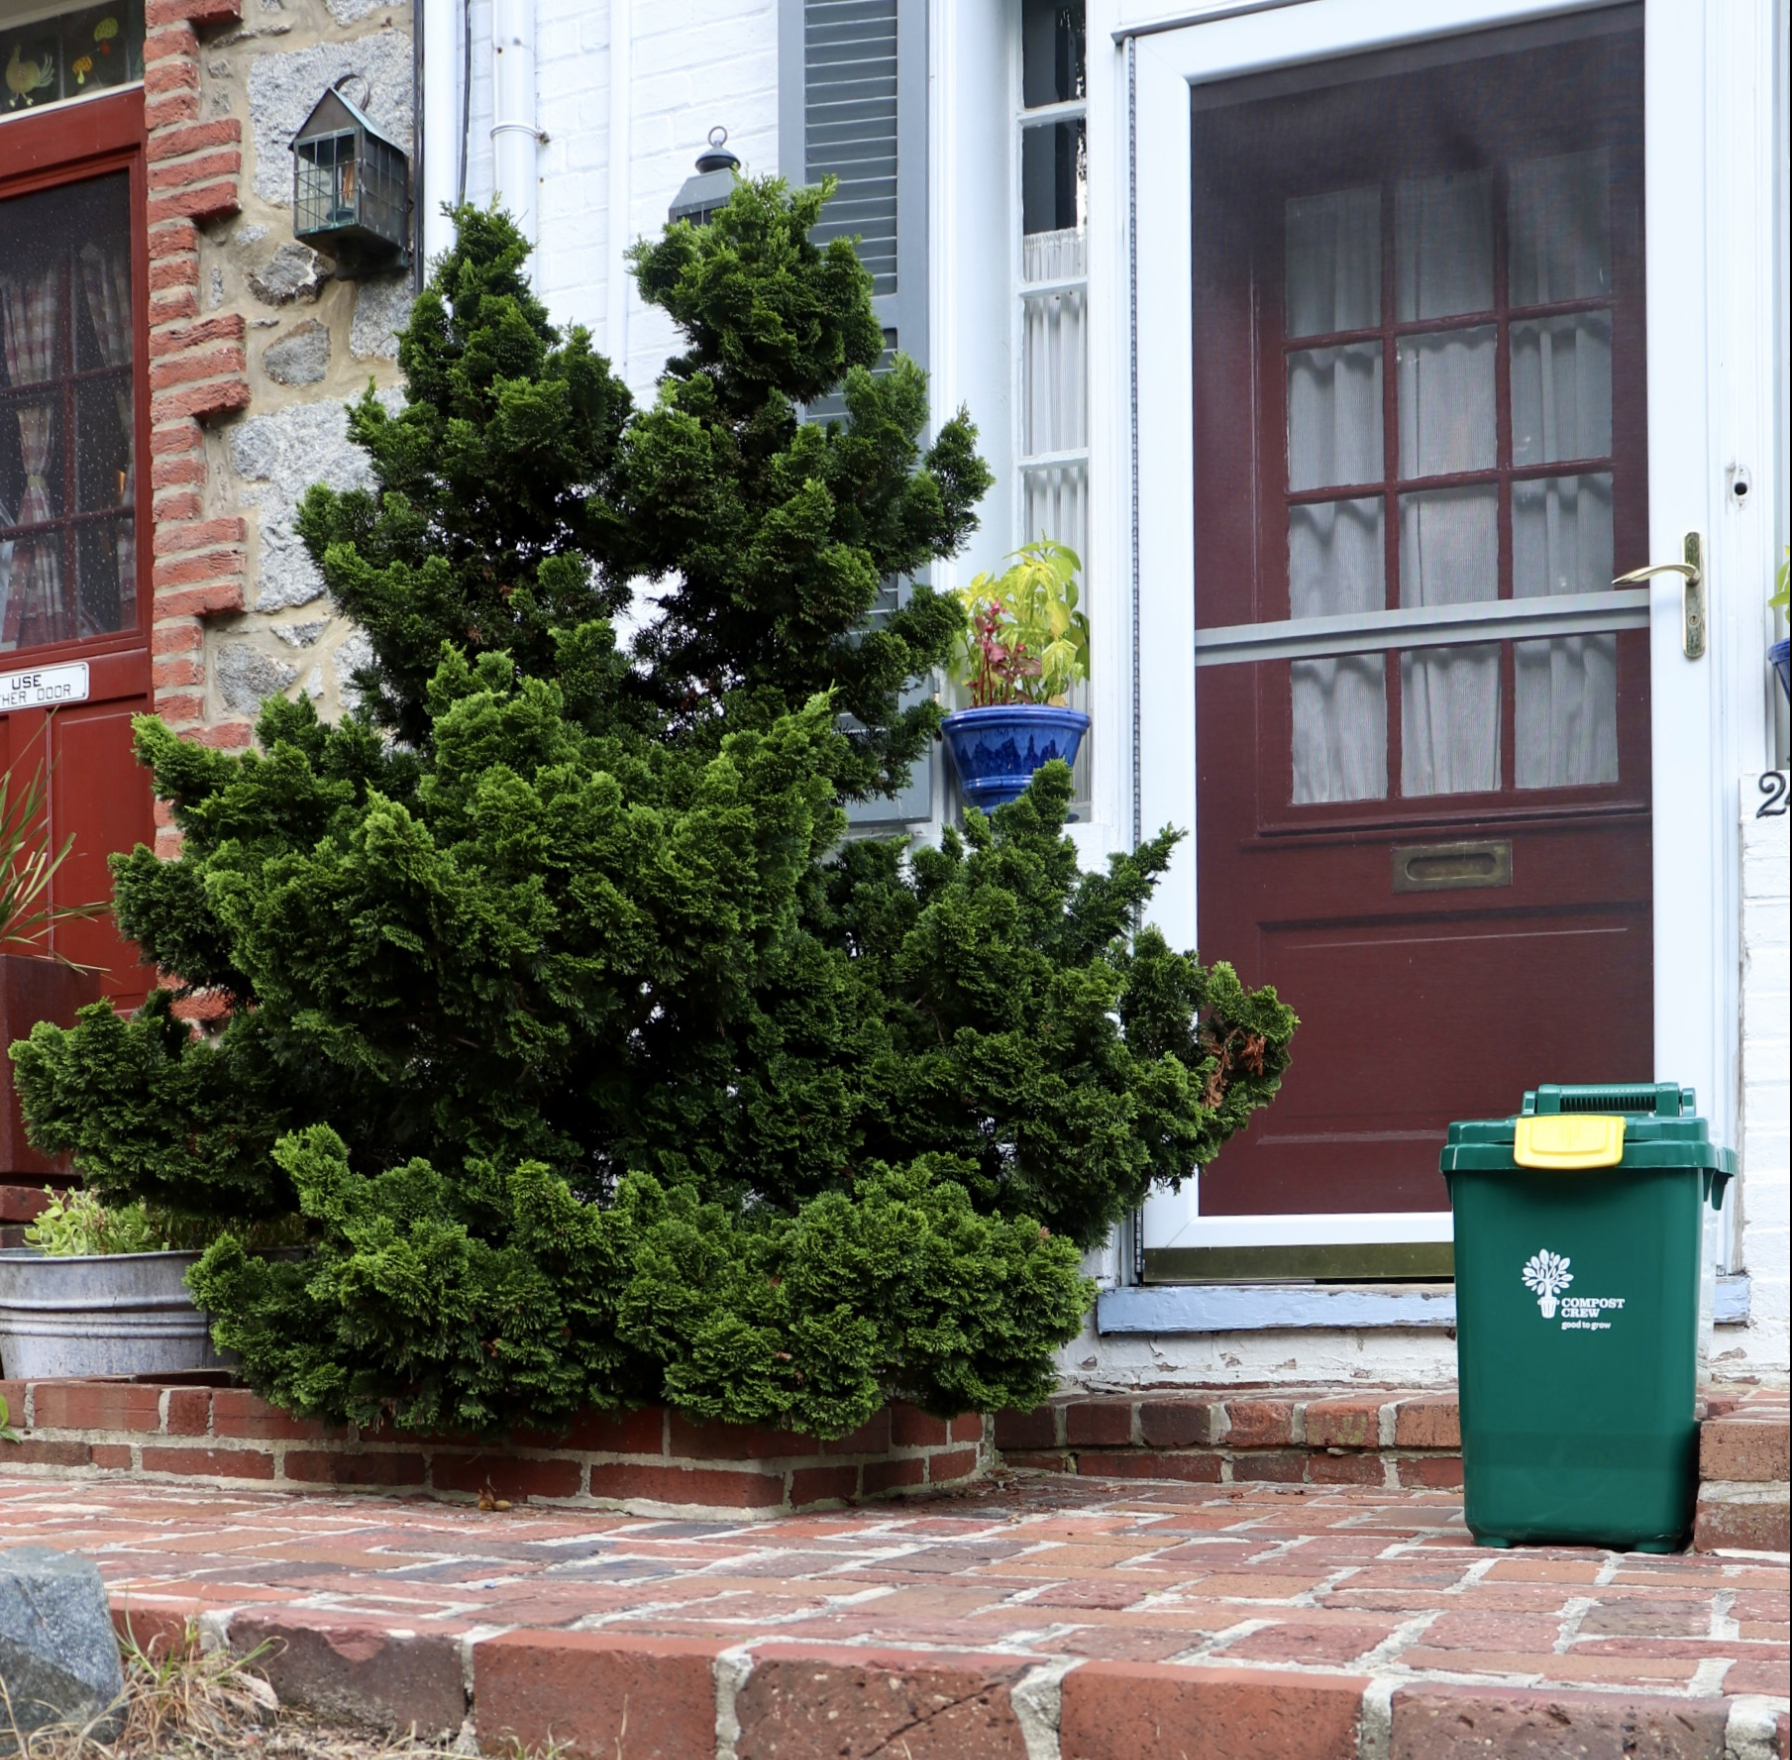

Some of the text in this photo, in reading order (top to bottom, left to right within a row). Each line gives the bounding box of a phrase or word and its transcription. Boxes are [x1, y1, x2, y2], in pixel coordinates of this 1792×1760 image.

[12, 674, 41, 690] USE
[0, 684, 71, 706] HER DOOR
[1561, 1297, 1625, 1309] COMPOST
[1561, 1308, 1600, 1318] CREW
[1561, 1320, 1611, 1331] good to grow
